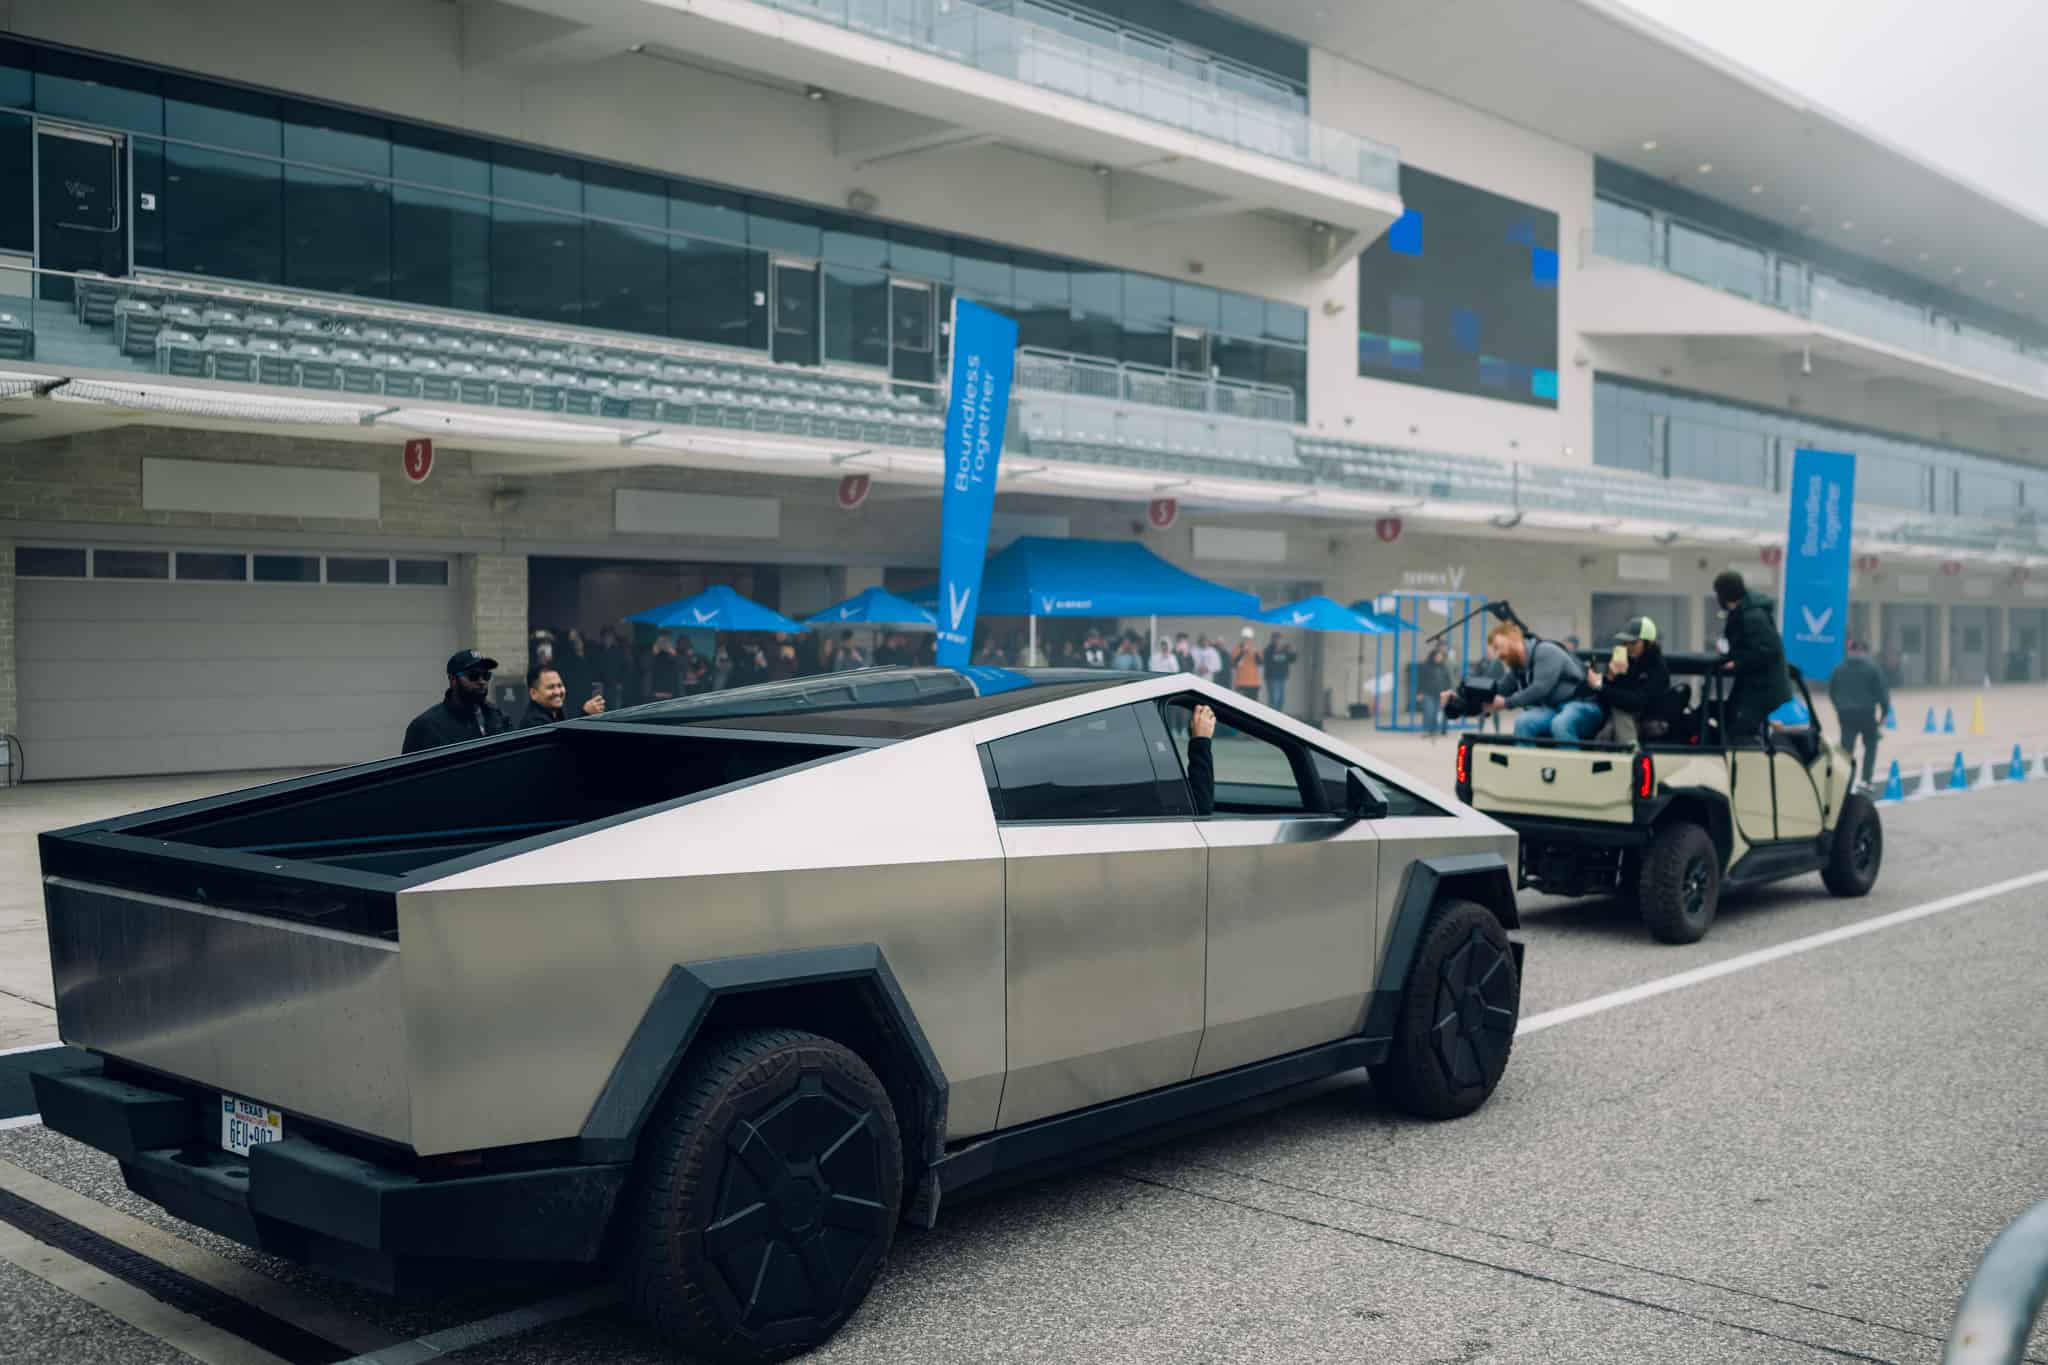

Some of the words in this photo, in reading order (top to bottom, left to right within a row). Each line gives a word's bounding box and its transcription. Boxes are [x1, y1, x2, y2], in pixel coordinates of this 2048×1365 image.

[413, 443, 424, 473] 3
[955, 355, 980, 491] Boundless
[971, 370, 994, 483] Together
[239, 1101, 264, 1118] TEXAS
